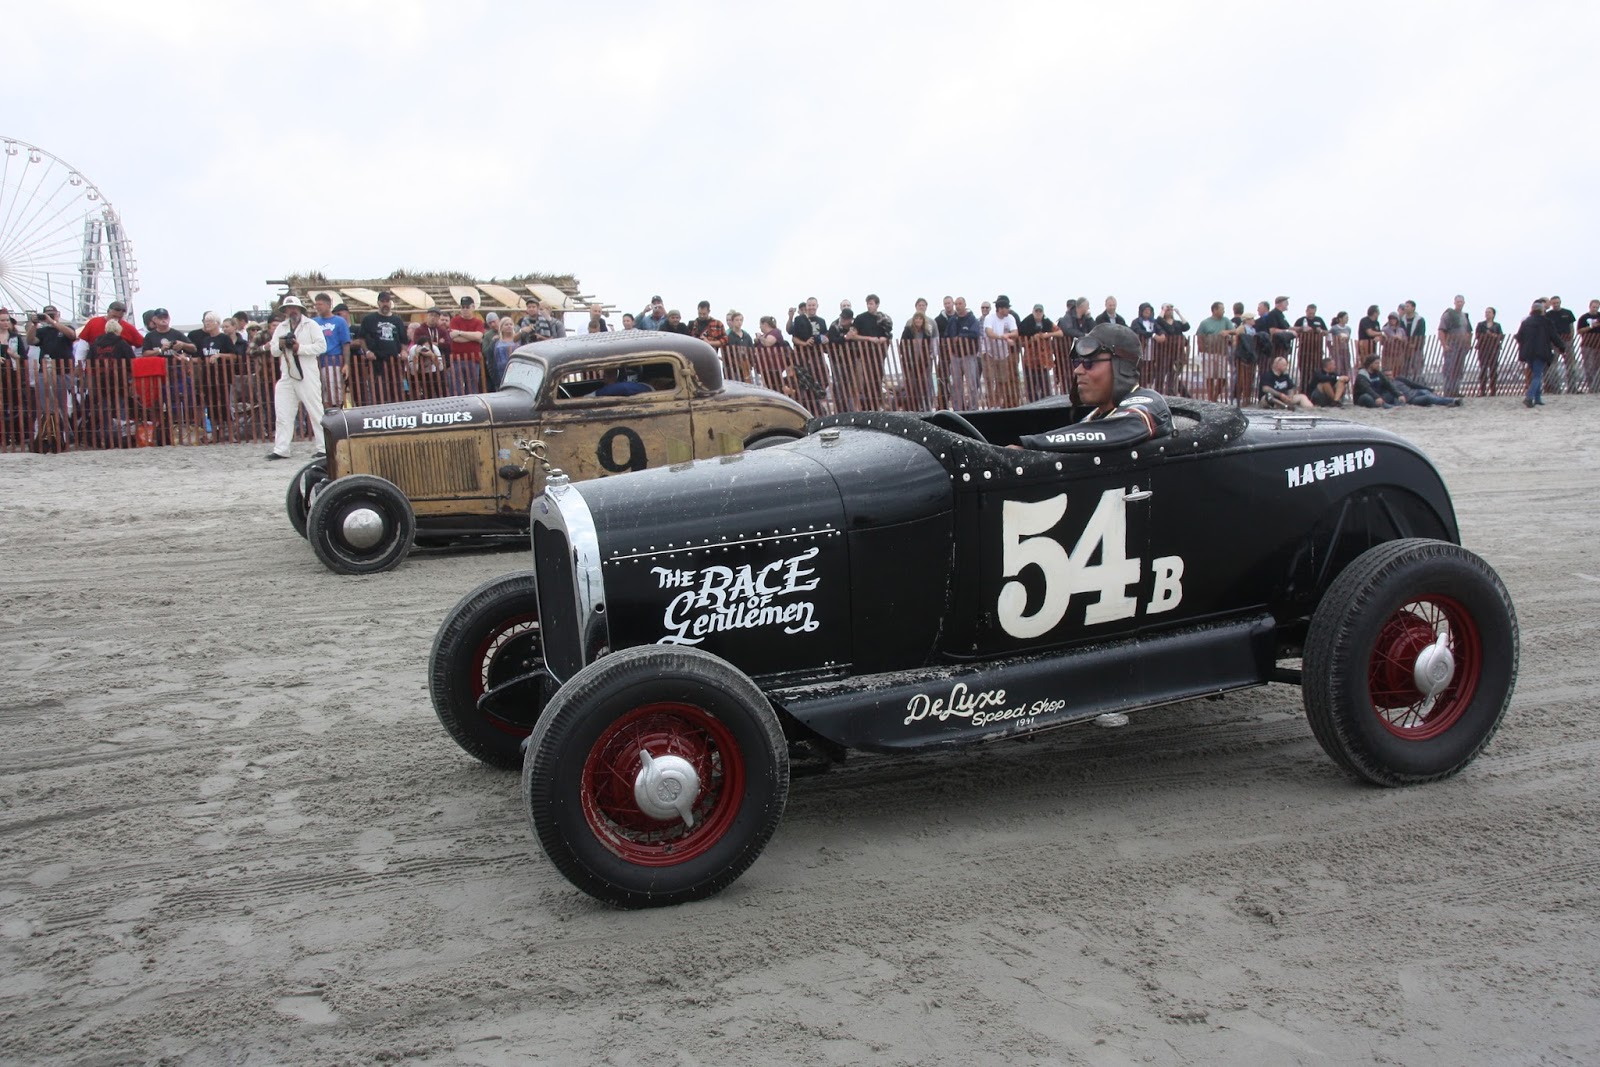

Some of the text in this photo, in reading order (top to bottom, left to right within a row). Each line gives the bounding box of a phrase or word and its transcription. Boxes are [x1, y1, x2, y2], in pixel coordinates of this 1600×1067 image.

[363, 411, 473, 429] rolling bones
[1046, 431, 1106, 443] vanson
[650, 546, 821, 614] THE RACE
[998, 487, 1141, 639] 54
[746, 594, 773, 609] OF
[1146, 555, 1185, 615] B
[656, 591, 820, 646] Gentlemen
[971, 697, 1066, 727] Speed Shop
